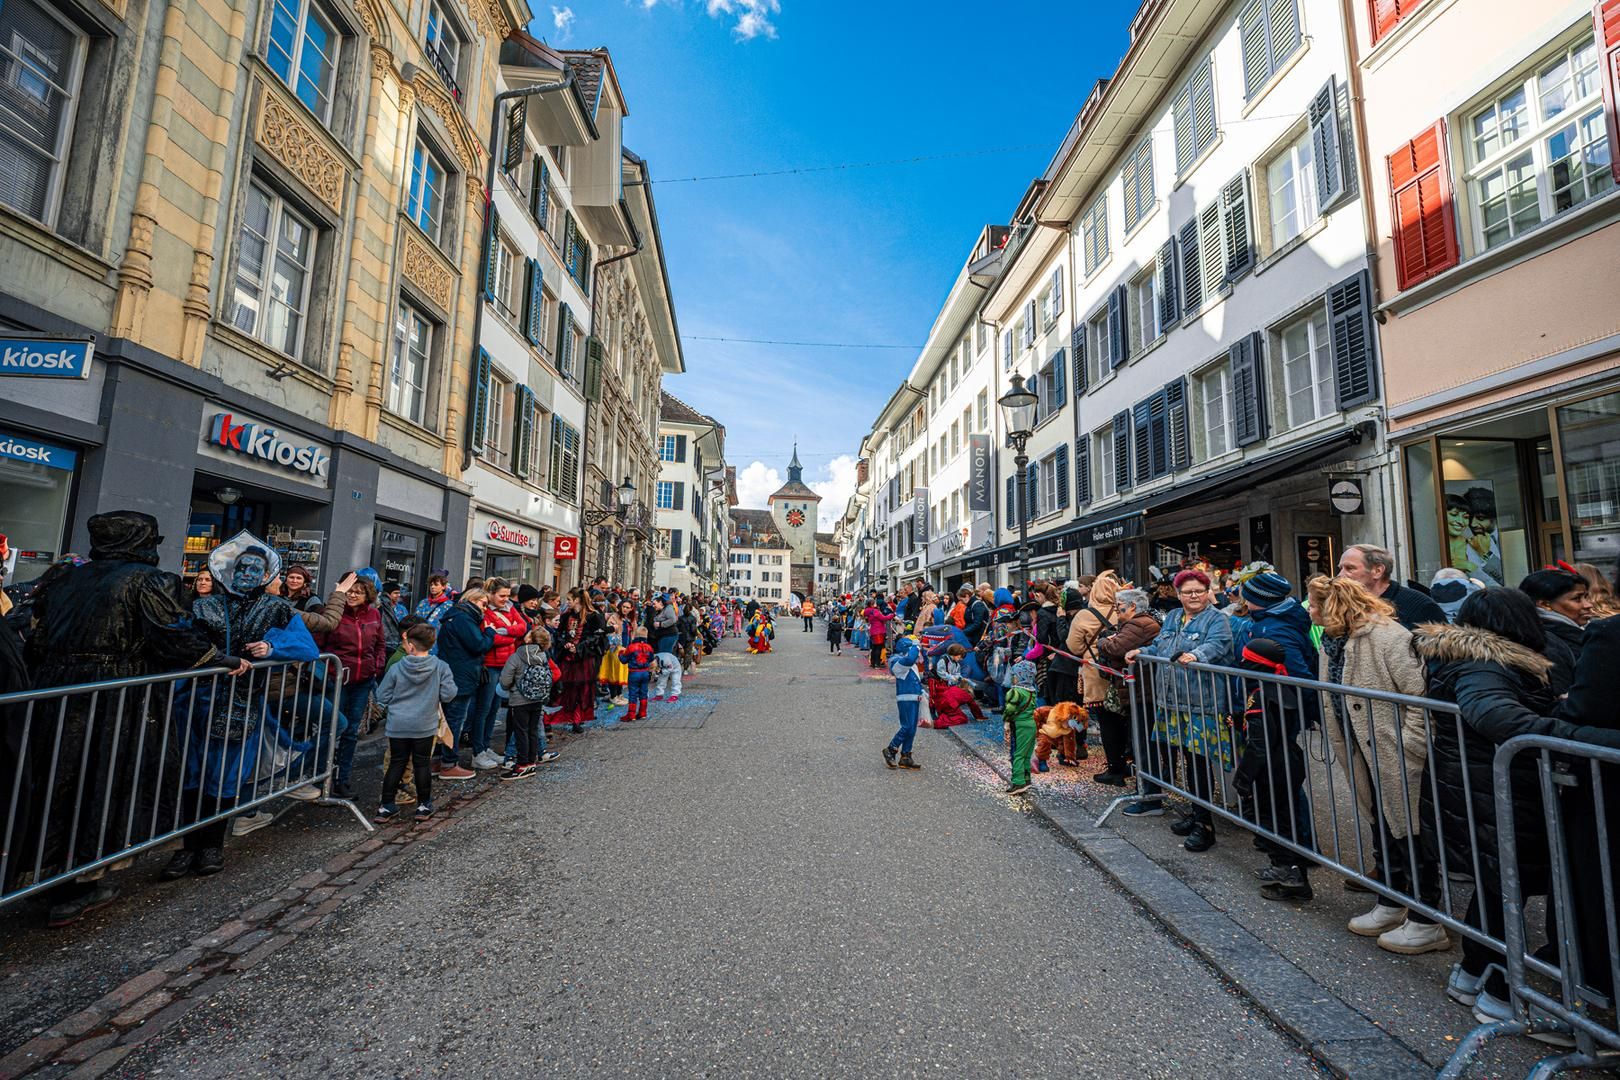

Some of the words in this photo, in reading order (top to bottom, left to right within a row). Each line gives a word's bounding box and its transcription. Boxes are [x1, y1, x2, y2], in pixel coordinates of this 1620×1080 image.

[2, 347, 76, 369] kiosk
[975, 447, 985, 502] MANOR
[917, 497, 925, 536] MANOR
[1257, 521, 1264, 530] H
[500, 525, 529, 547] Sunrise
[1056, 539, 1063, 552] H
